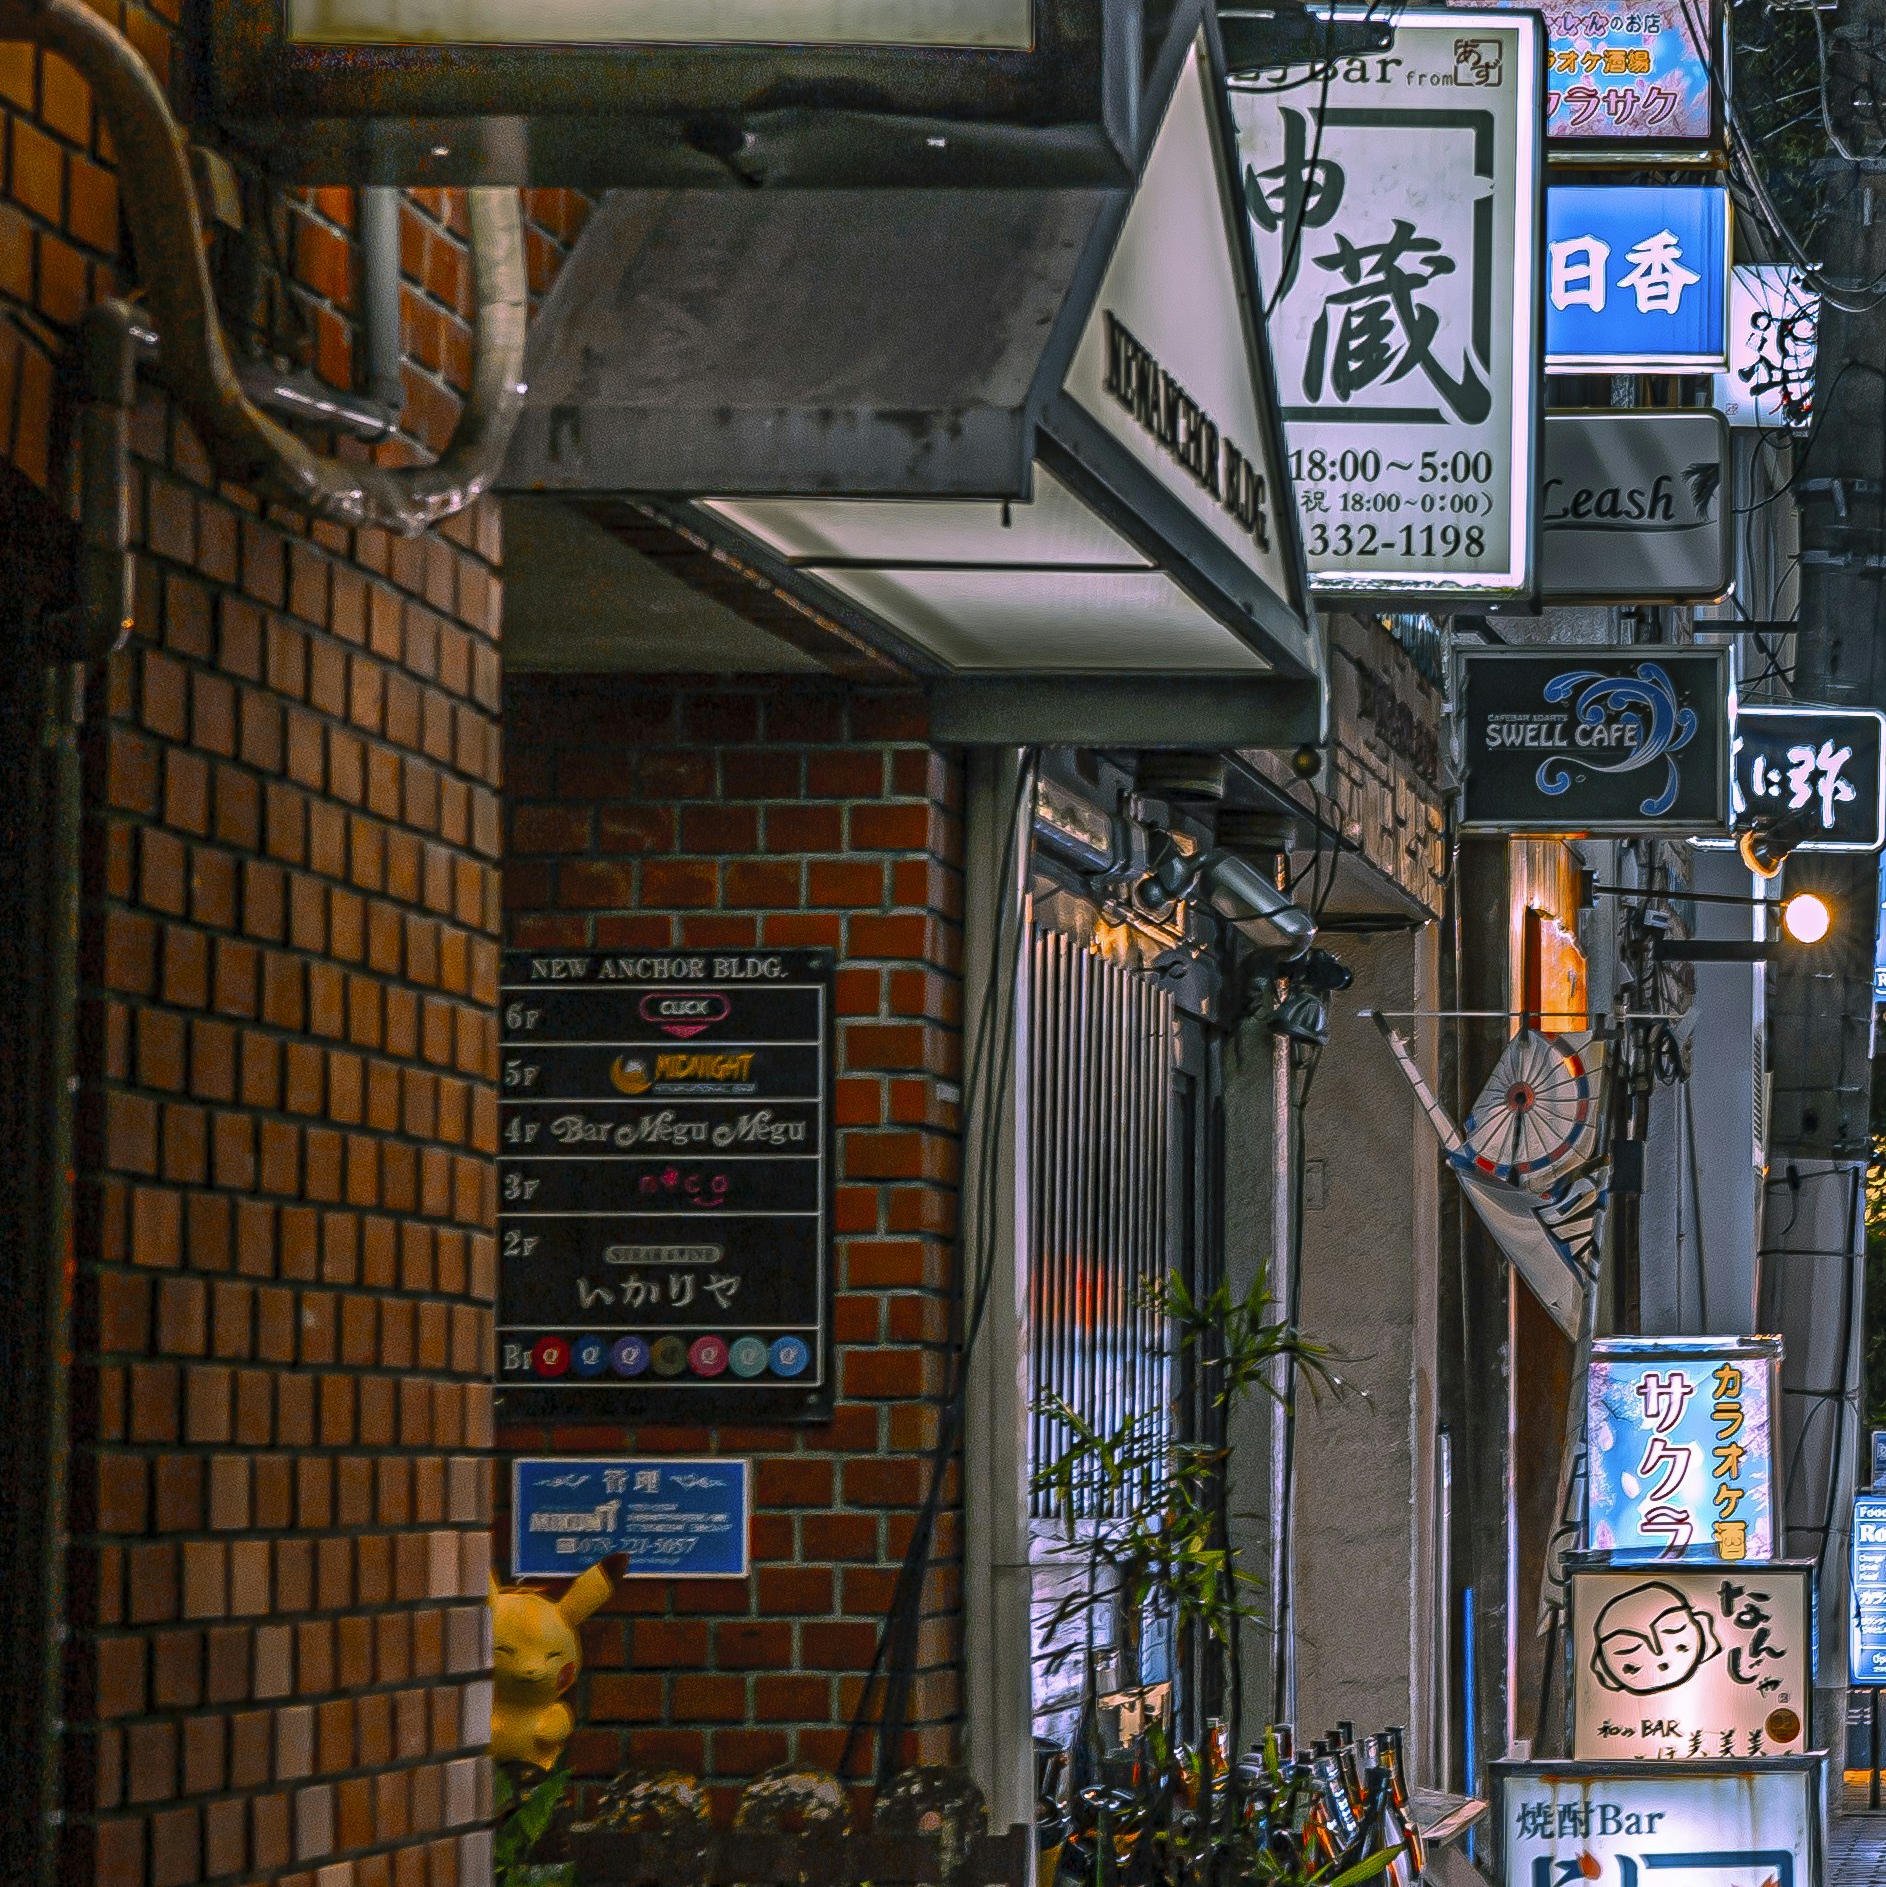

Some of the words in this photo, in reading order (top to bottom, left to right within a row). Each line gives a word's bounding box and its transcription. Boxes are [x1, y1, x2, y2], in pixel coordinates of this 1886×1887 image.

[1485, 722, 1568, 748] SWELL
[1574, 722, 1640, 747] CAFE
[531, 957, 590, 980] NEW
[599, 957, 706, 980] ANCHOR
[505, 998, 541, 1030] 6F
[502, 1058, 541, 1087] 5F
[505, 1114, 540, 1144] 4F
[501, 1172, 540, 1201] 3F
[502, 1229, 541, 1258] 2F
[576, 1272, 742, 1310] いかりや
[1636, 1372, 1694, 1560] サクラ
[1711, 1363, 1748, 1561] カラオケ酒
[1640, 1719, 1683, 1739] BAR
